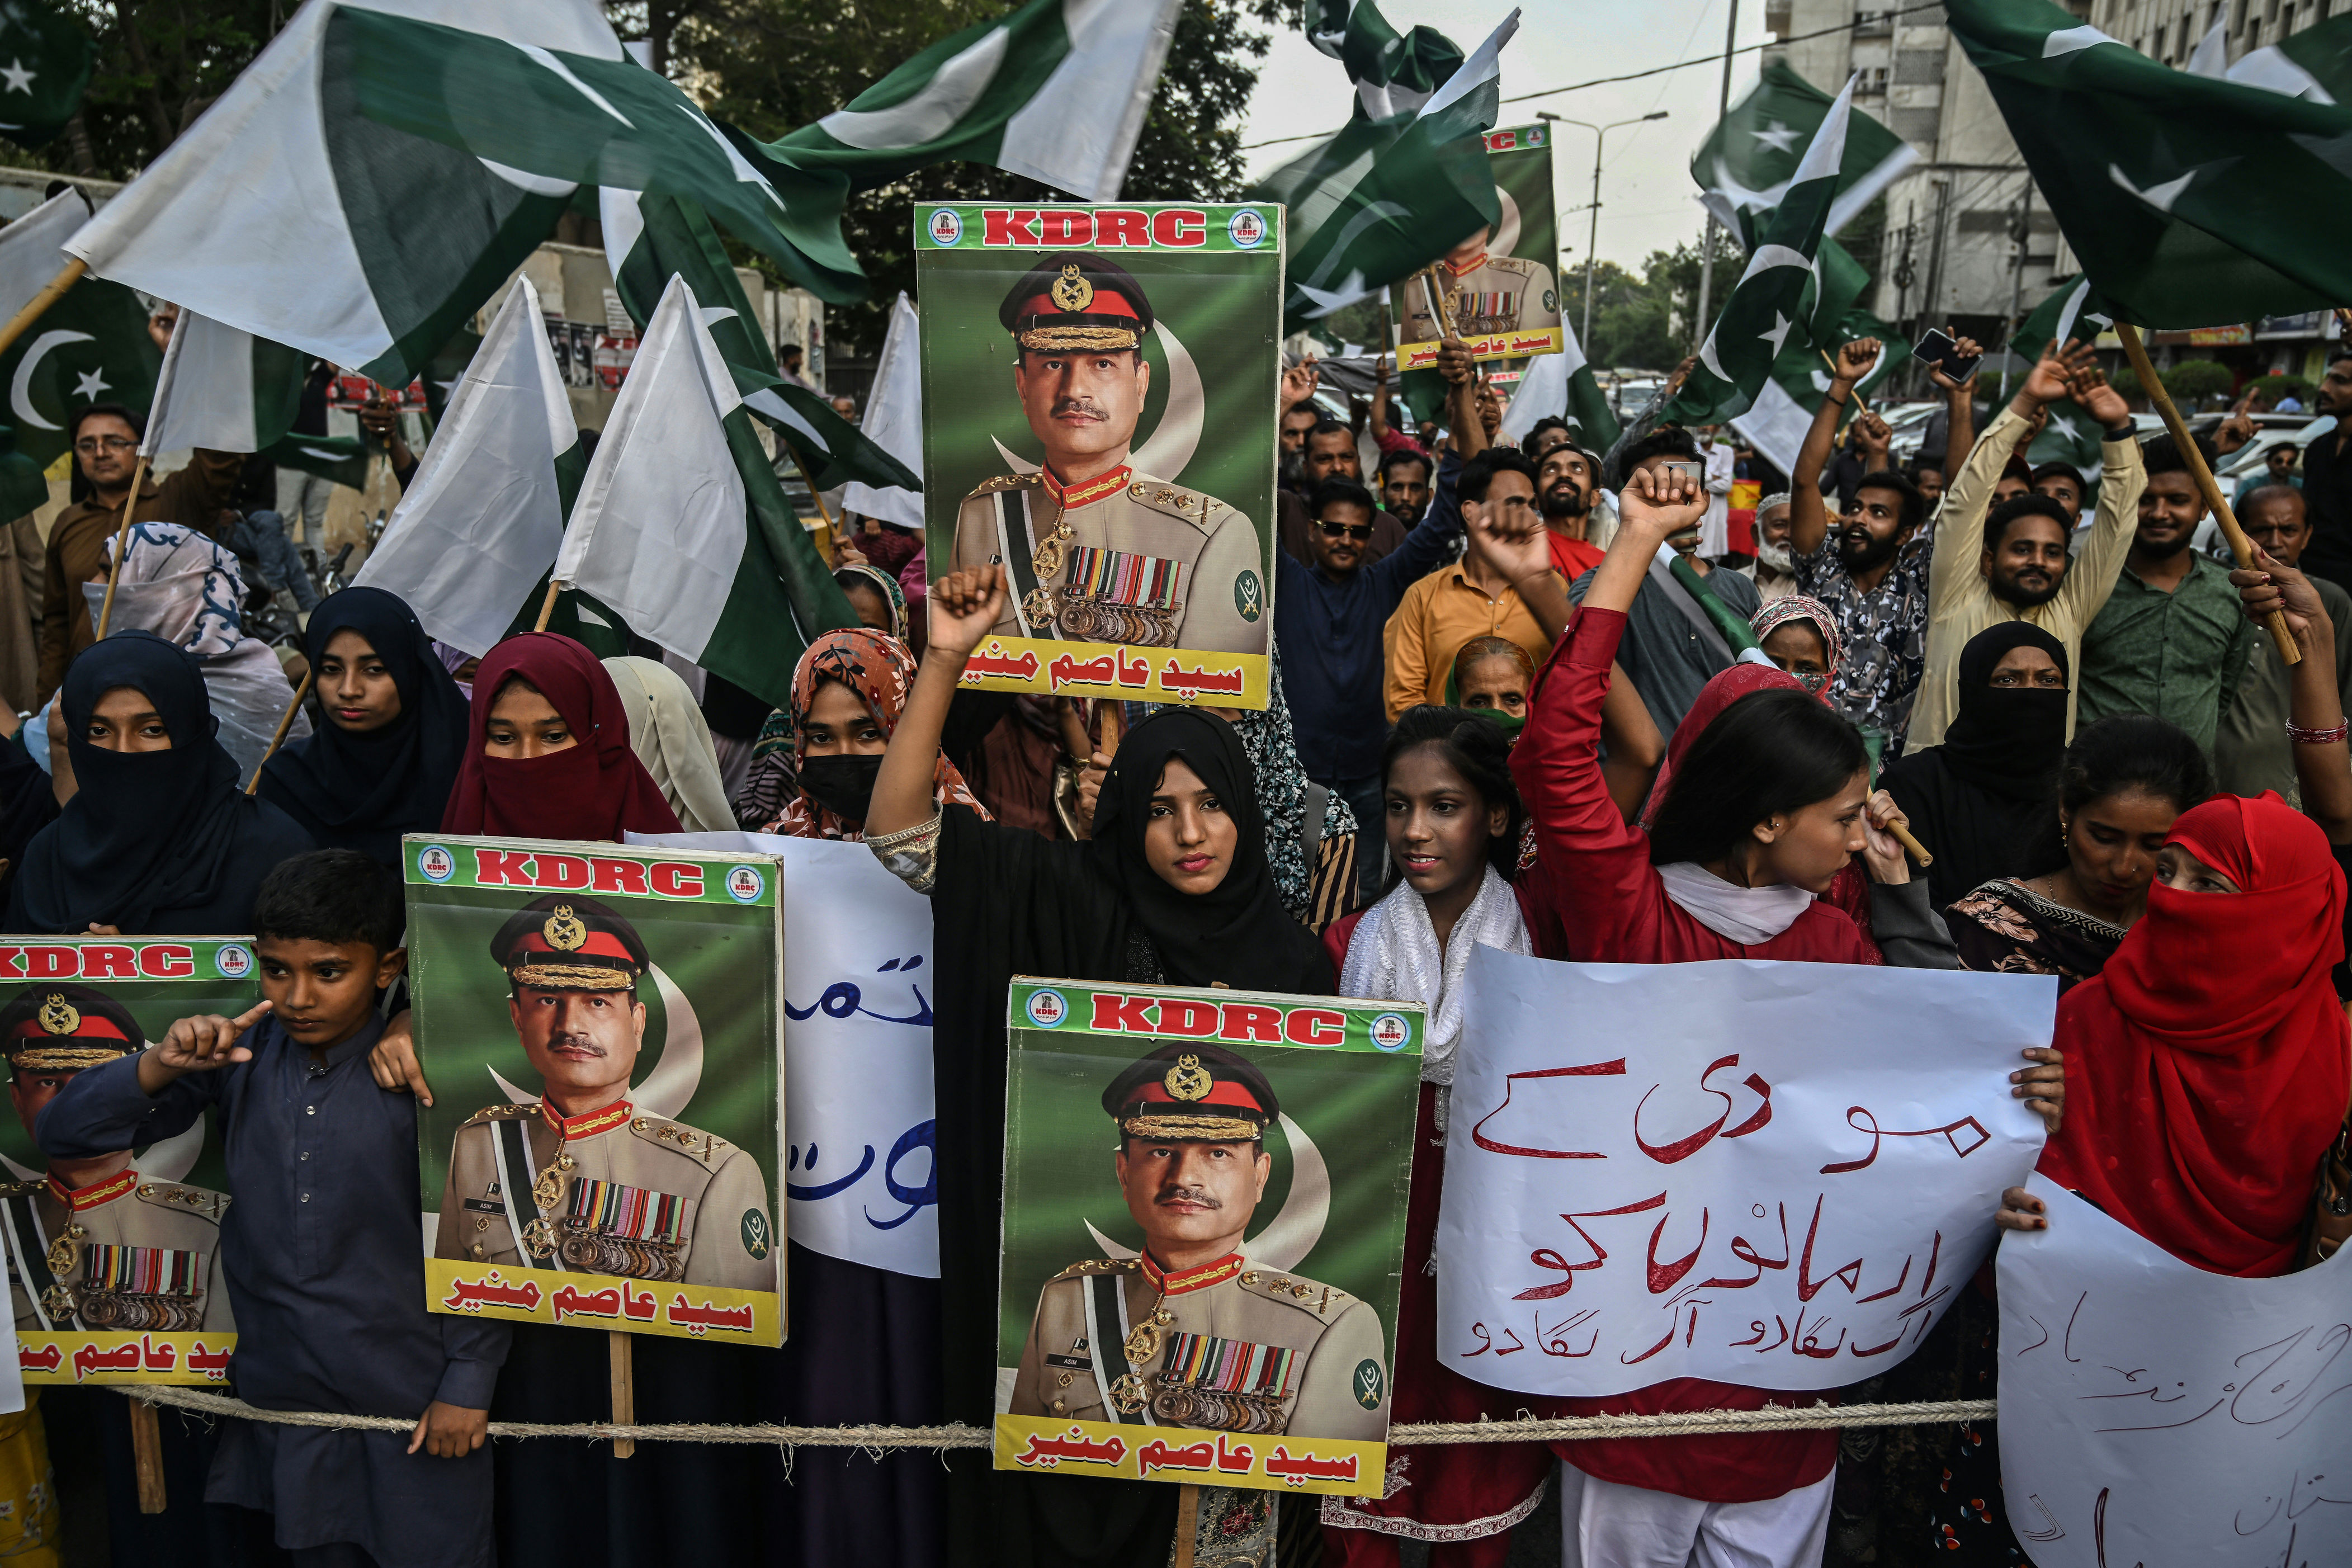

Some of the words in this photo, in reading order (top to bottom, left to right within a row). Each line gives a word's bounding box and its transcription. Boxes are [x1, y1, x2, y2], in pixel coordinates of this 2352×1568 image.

[983, 210, 1206, 247] KDRC
[1406, 343, 1441, 367] نیر
[1473, 336, 1505, 356] عاص
[960, 641, 1040, 682] منی
[1049, 646, 1151, 693] عاصم
[1160, 658, 1243, 702] سید
[475, 849, 704, 897] KDRC
[1091, 993, 1346, 1047] KDRC
[443, 1269, 542, 1311] منیر
[552, 1279, 658, 1324] عاصم
[668, 1292, 754, 1336] سید
[73, 1333, 177, 1382] عاصم
[187, 1342, 231, 1379] ید
[1014, 1425, 1128, 1467] منیر
[1137, 1433, 1255, 1478] عاصم
[1265, 1444, 1358, 1485] سید
